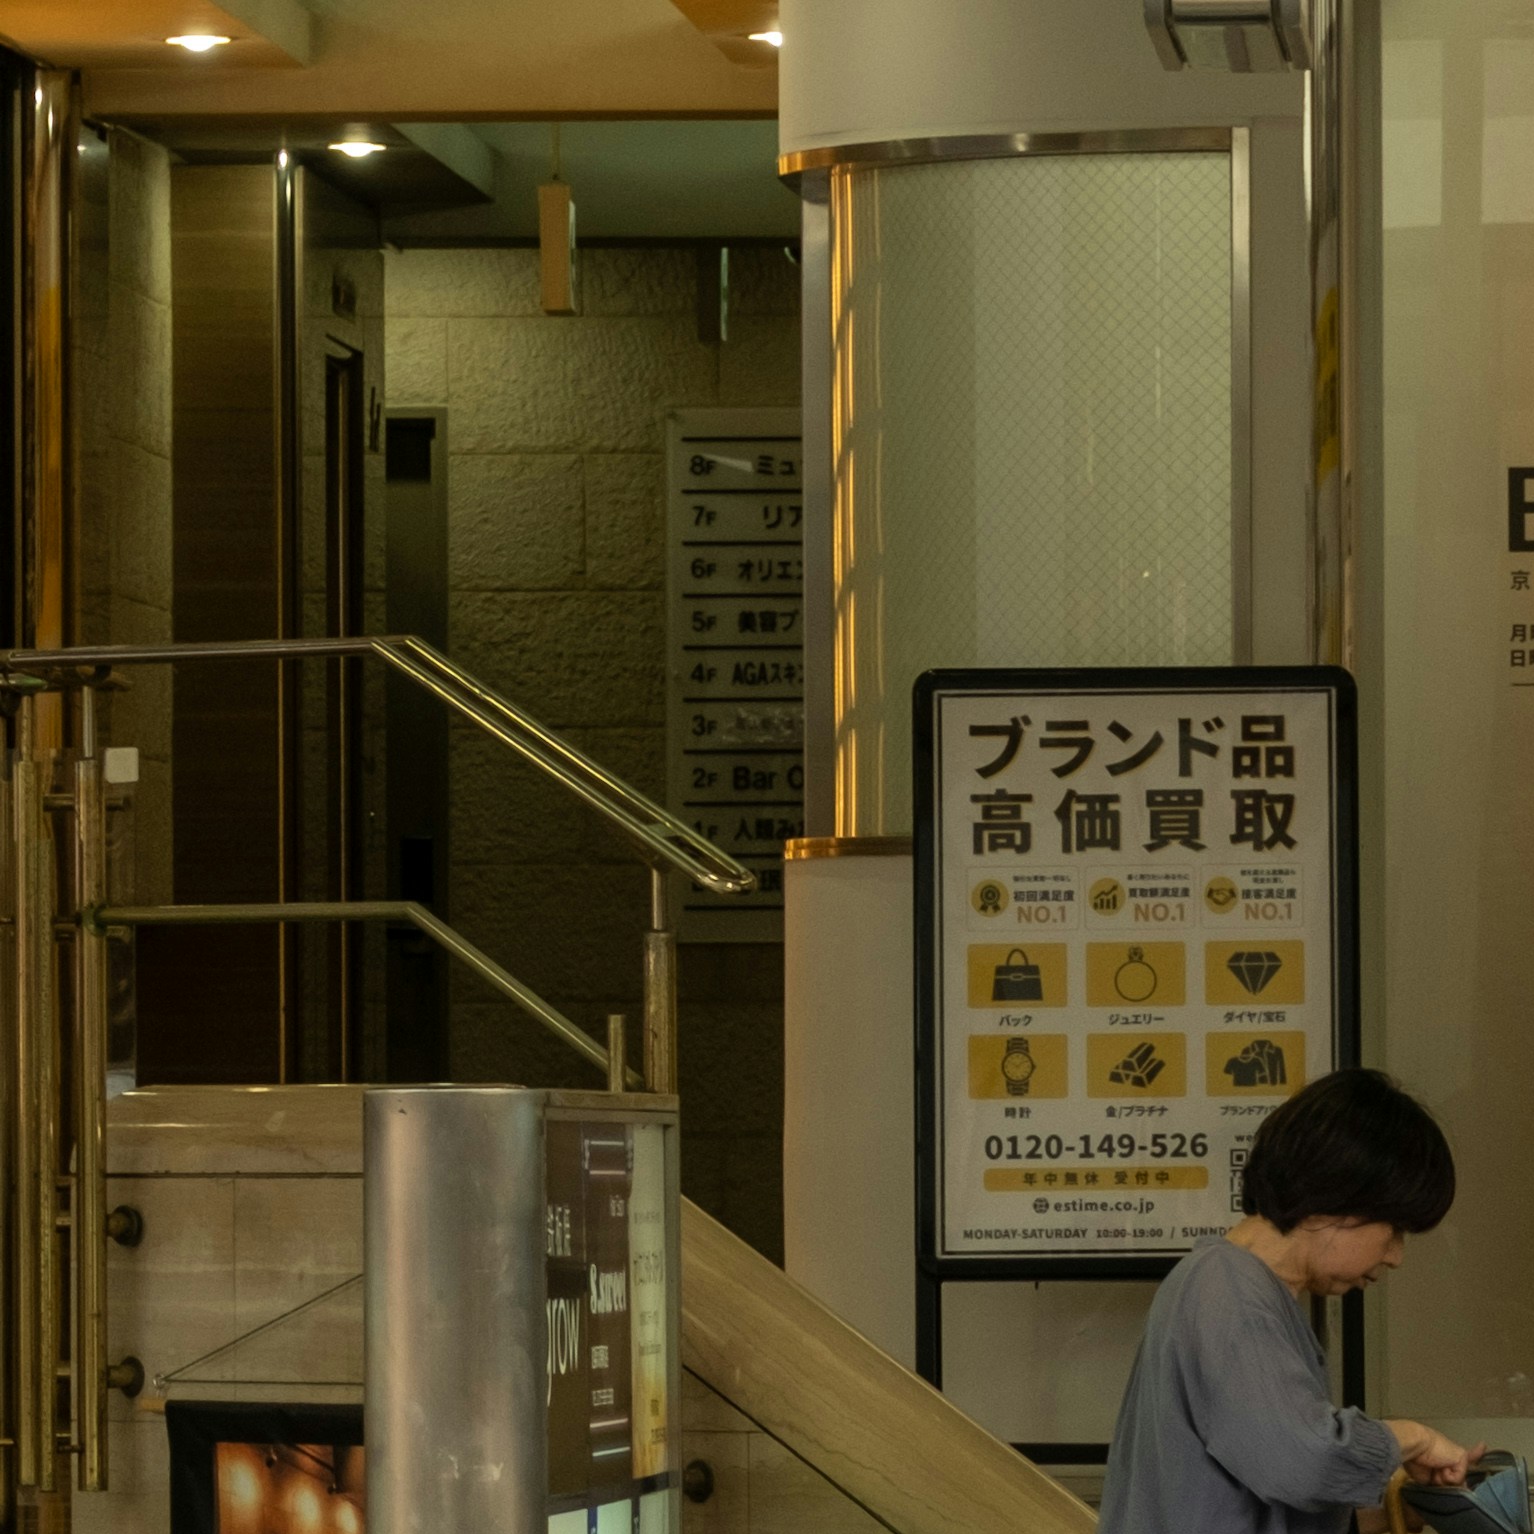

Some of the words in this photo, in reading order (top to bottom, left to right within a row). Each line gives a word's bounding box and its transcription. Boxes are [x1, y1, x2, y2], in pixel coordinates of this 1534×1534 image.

[689, 454, 717, 476] 8F
[692, 505, 717, 526] 7F
[690, 558, 717, 580] 6F
[691, 610, 717, 633] 5F
[690, 662, 717, 685] 4F
[691, 714, 718, 737] 3F
[968, 715, 1296, 780] ブランド品
[692, 767, 718, 790] 2F
[732, 765, 776, 791] Bar
[970, 788, 1298, 856] 高価買取
[1016, 906, 1068, 924] NO.1
[1134, 903, 1187, 922] NO.1
[1244, 902, 1293, 921] NO.1
[1108, 1014, 1165, 1026] ジュエリー
[1004, 1107, 1032, 1119] 時計
[1105, 1105, 1169, 1119] 金/プラチナ
[984, 1132, 1209, 1160] 0120-149-526
[1023, 1172, 1100, 1187] 年中無休
[1113, 1170, 1171, 1186] 受付中
[1053, 1198, 1155, 1215] estime.co.jp
[963, 1228, 1089, 1241] MONDAY-SATURDAY
[1096, 1227, 1164, 1239] 10:00-19:00
[1181, 1226, 1234, 1239] SUNND
